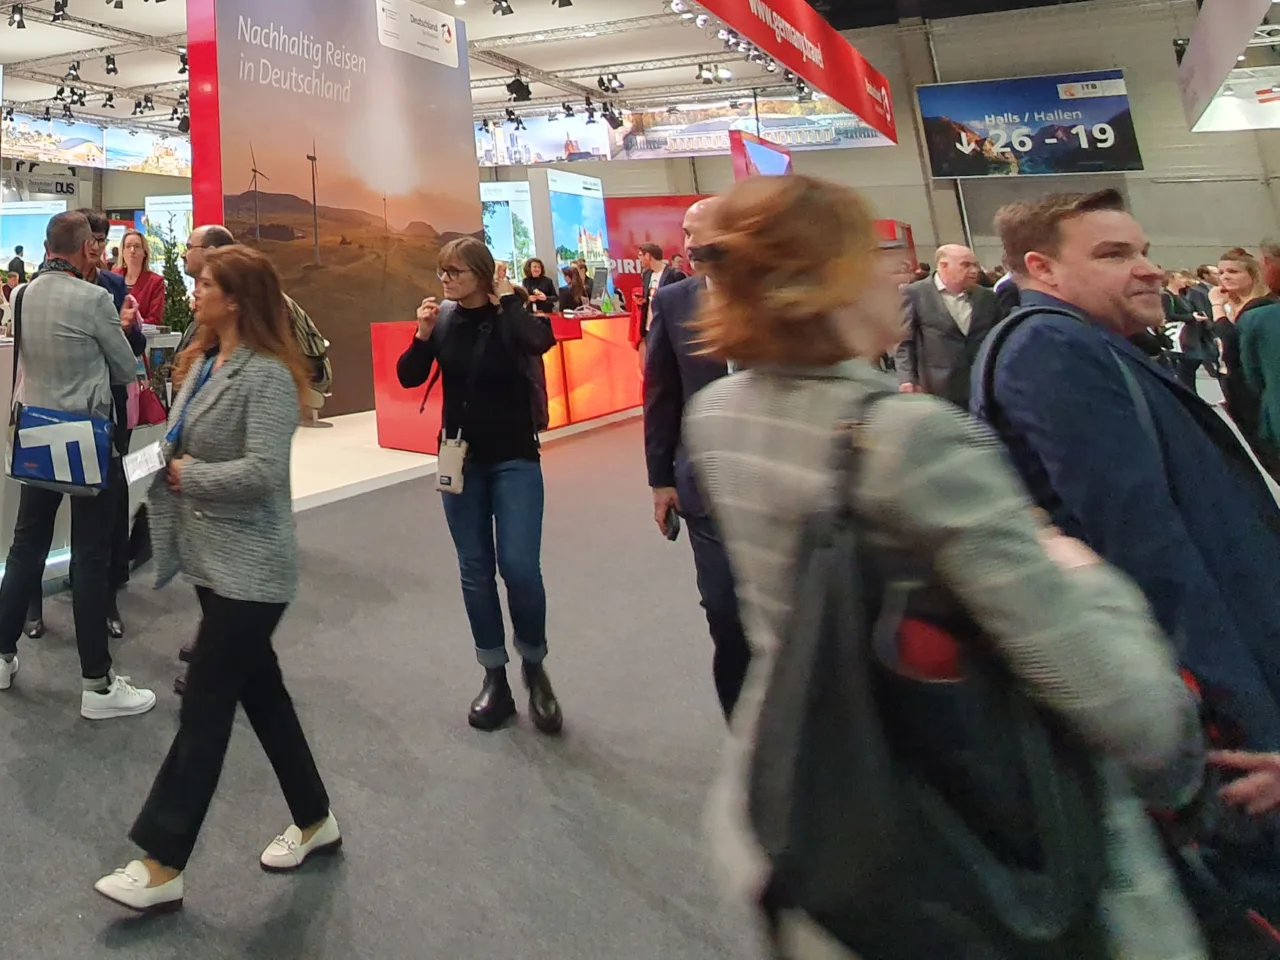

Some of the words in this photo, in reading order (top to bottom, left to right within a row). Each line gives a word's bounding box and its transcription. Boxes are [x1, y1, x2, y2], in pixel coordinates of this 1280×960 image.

[237, 15, 322, 70] Nachhaltig
[326, 41, 367, 74] Reisen
[238, 53, 255, 81] in
[258, 58, 352, 104] Deutschland
[984, 112, 1020, 125] Halls
[1034, 109, 1083, 122] Hallen
[989, 127, 1033, 153] 26
[1070, 123, 1116, 150] 19
[55, 181, 75, 195] DUS
